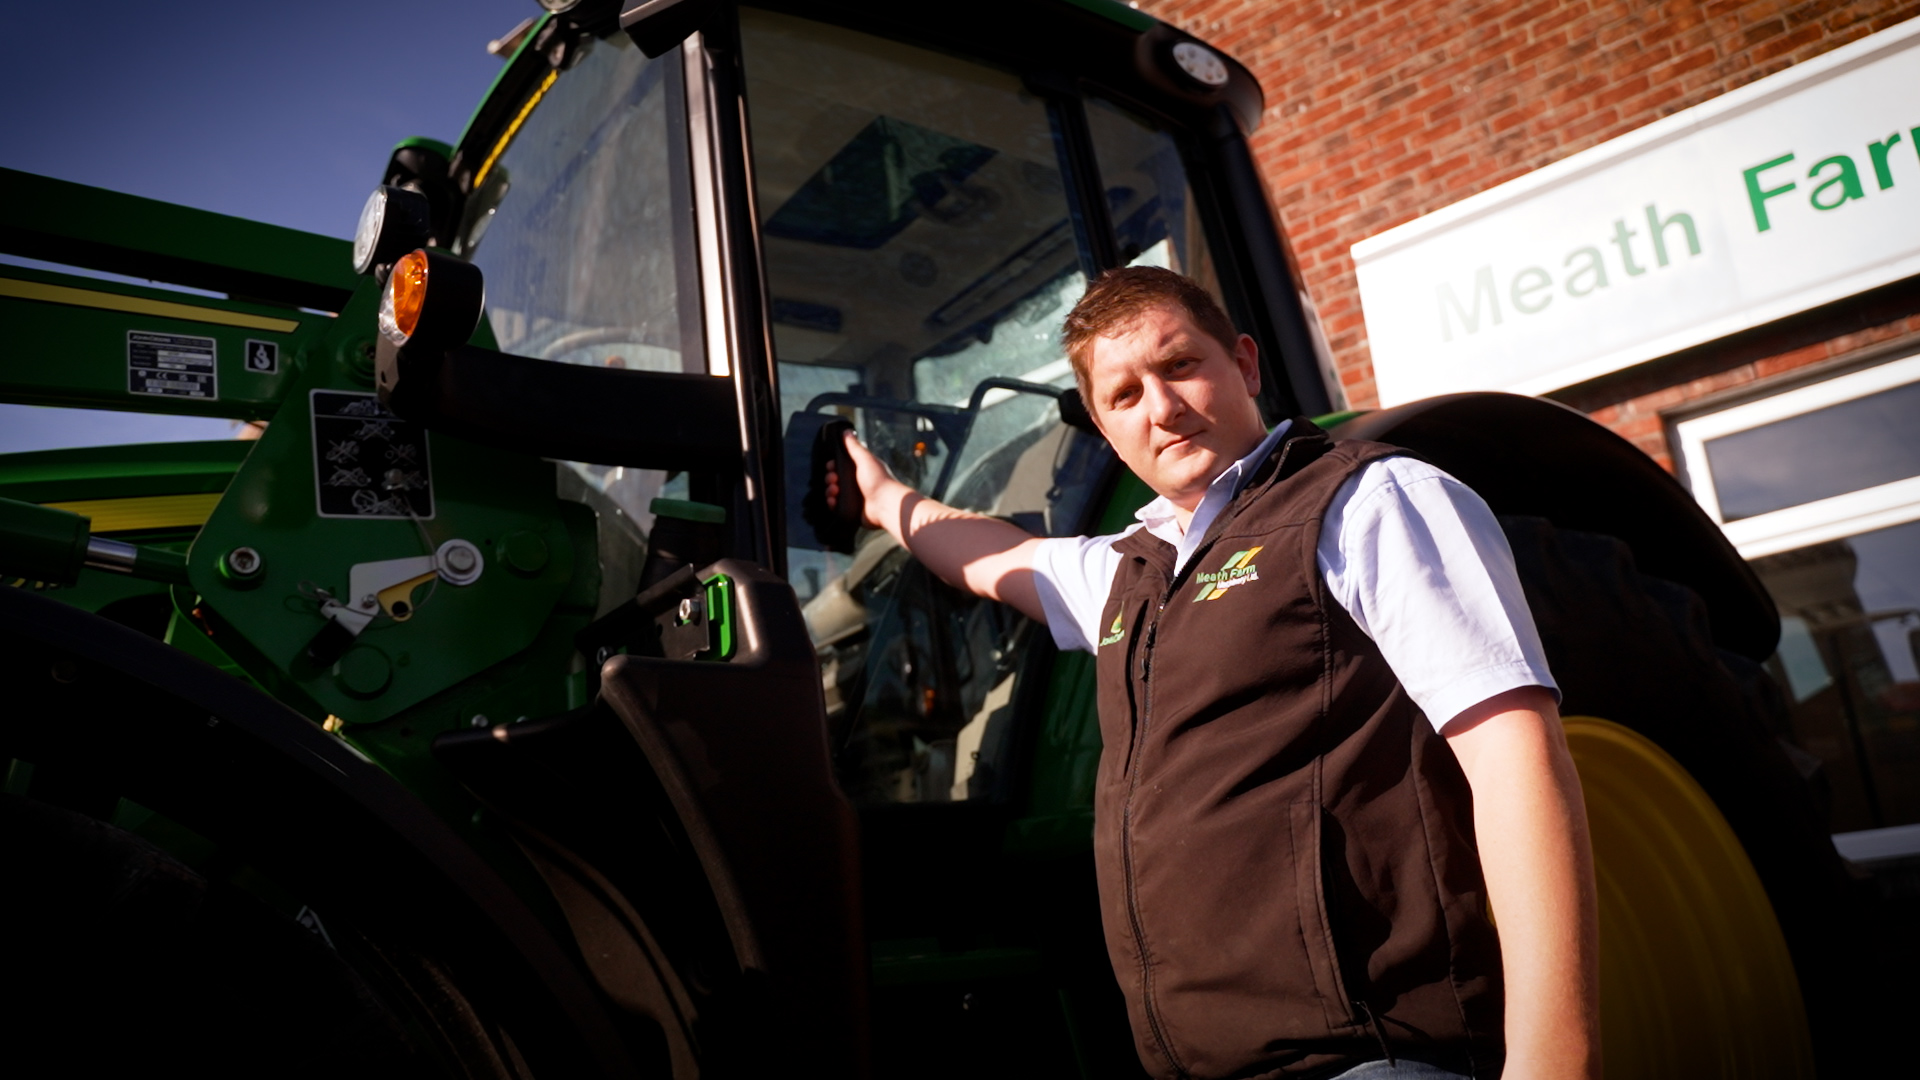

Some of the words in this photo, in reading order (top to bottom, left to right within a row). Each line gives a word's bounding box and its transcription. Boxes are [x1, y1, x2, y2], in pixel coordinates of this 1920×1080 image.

[1434, 203, 1702, 342] Meath
[1196, 570, 1228, 584] Meath
[1229, 564, 1256, 579] Farm
